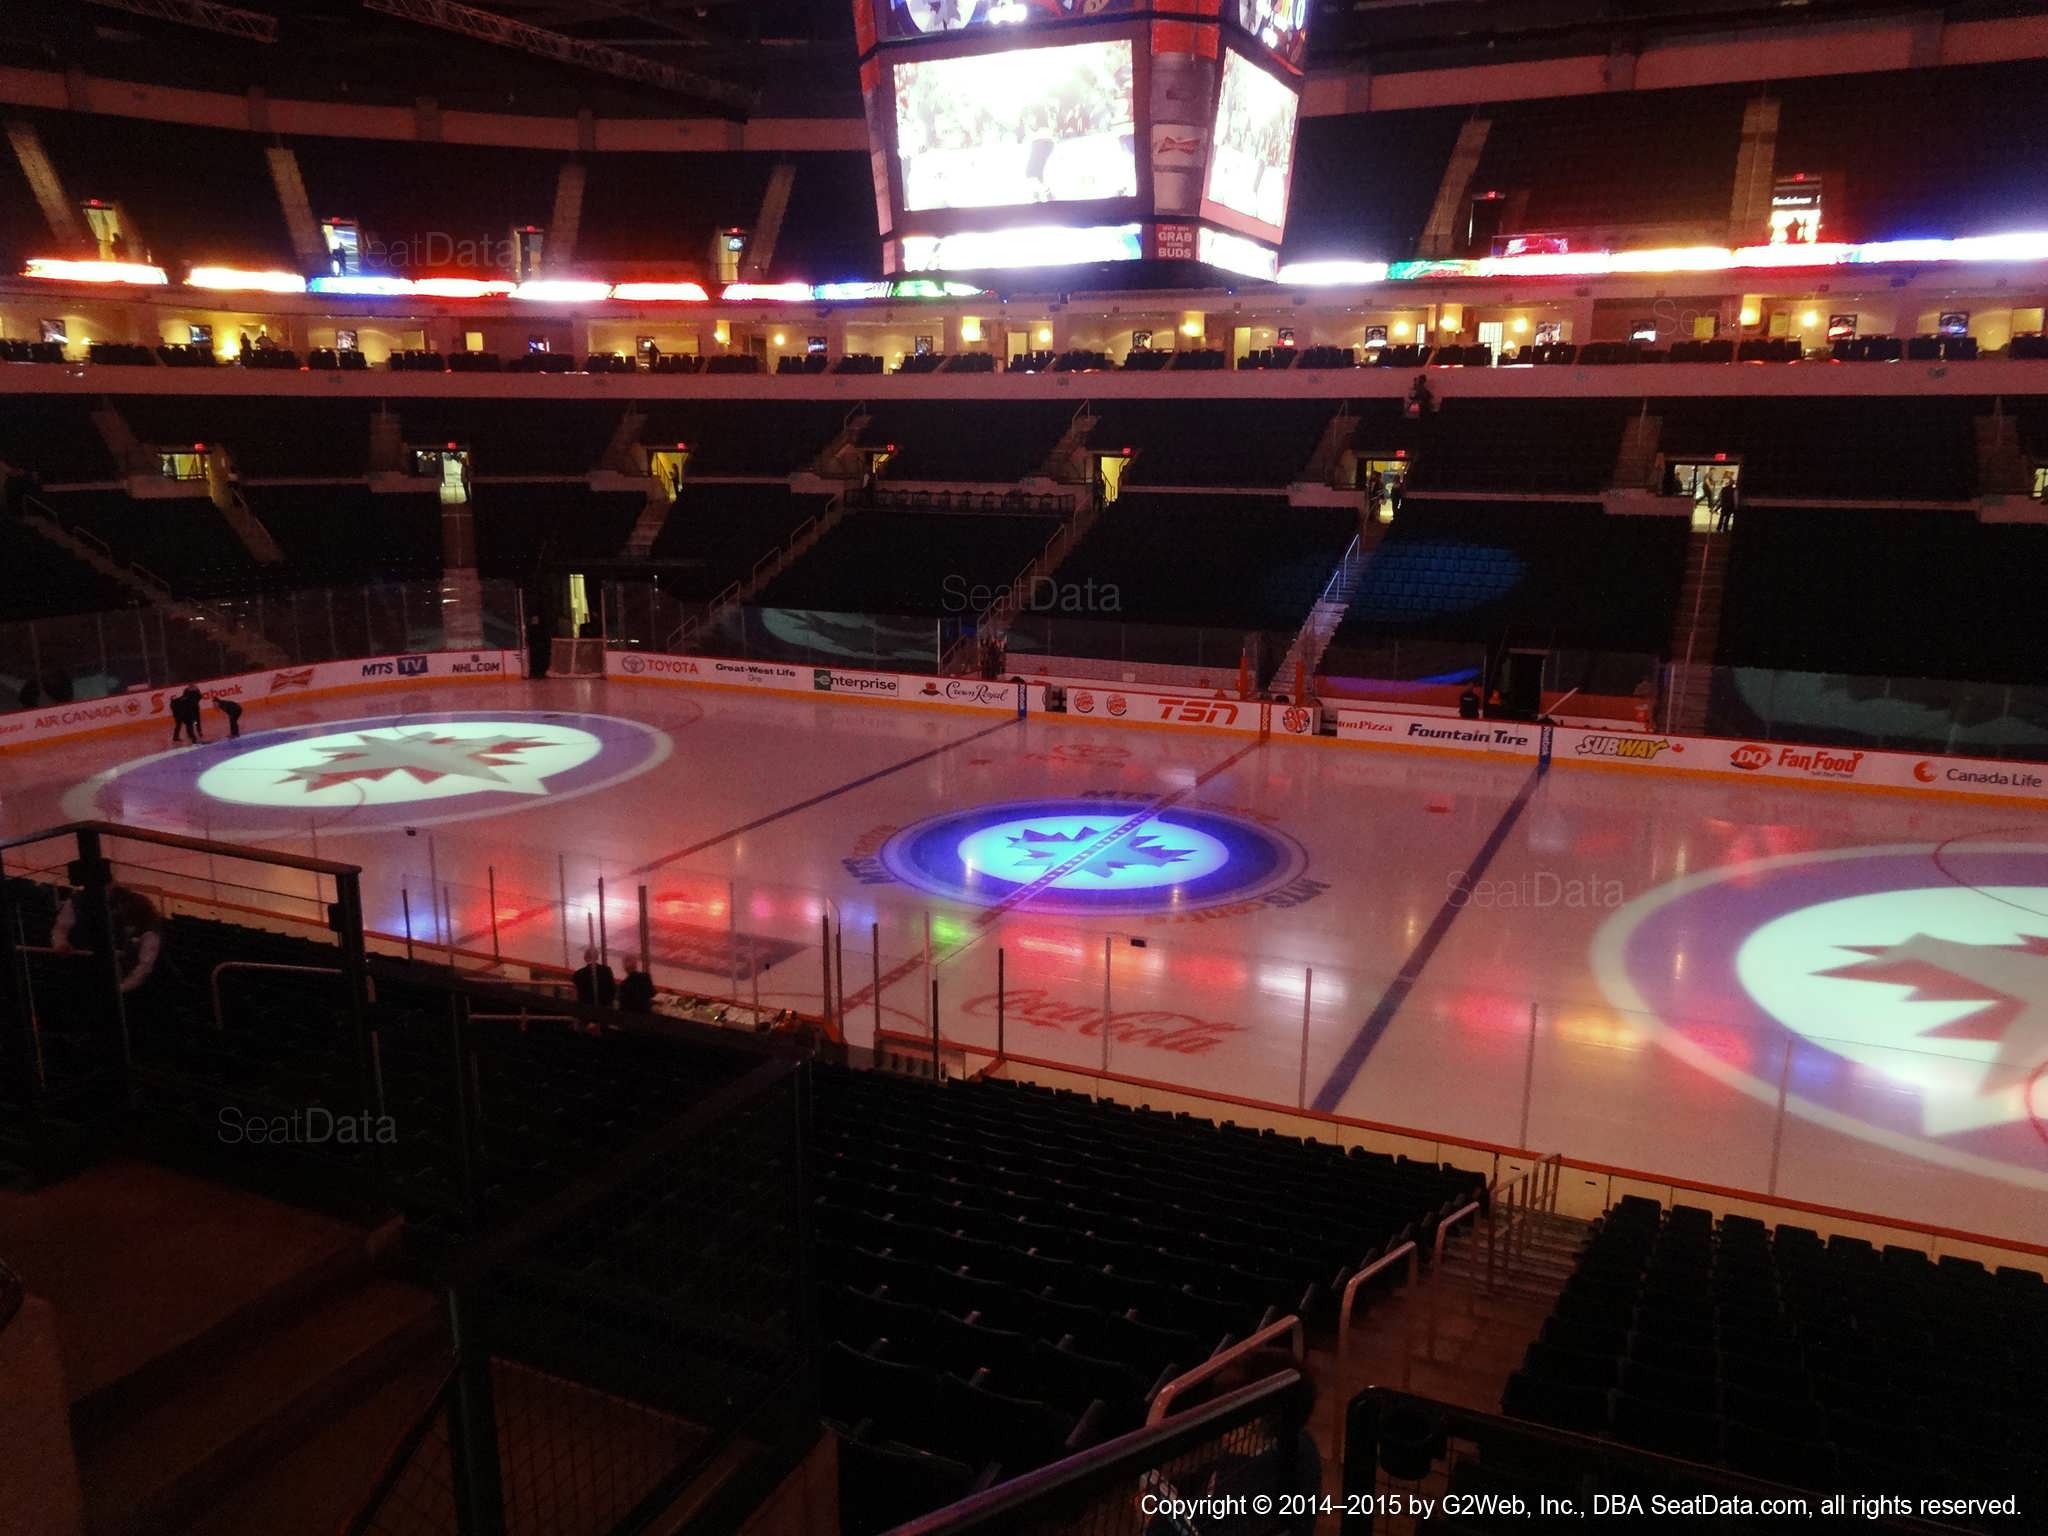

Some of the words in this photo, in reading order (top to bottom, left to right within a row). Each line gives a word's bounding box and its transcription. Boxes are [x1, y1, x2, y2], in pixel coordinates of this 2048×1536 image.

[1158, 231, 1193, 243] GRAB
[1158, 247, 1192, 258] BUDS
[361, 661, 393, 677] MTS
[400, 657, 423, 673] TV
[451, 662, 500, 673] NHL.COM
[647, 658, 699, 675] TOYOTA
[715, 663, 774, 677] Great-West
[776, 667, 796, 678] Life
[819, 674, 897, 691] enterprise
[945, 680, 975, 698] Crown
[970, 683, 1009, 704] Royal
[34, 716, 59, 729] AIR
[62, 704, 122, 726] CANADA
[1157, 698, 1240, 725] TSN
[1407, 722, 1491, 745] Fountain
[1493, 729, 1528, 747] Tire
[1575, 734, 1670, 760] SUBWAY
[1946, 767, 2009, 786] Canada
[2012, 774, 2043, 788] Life
